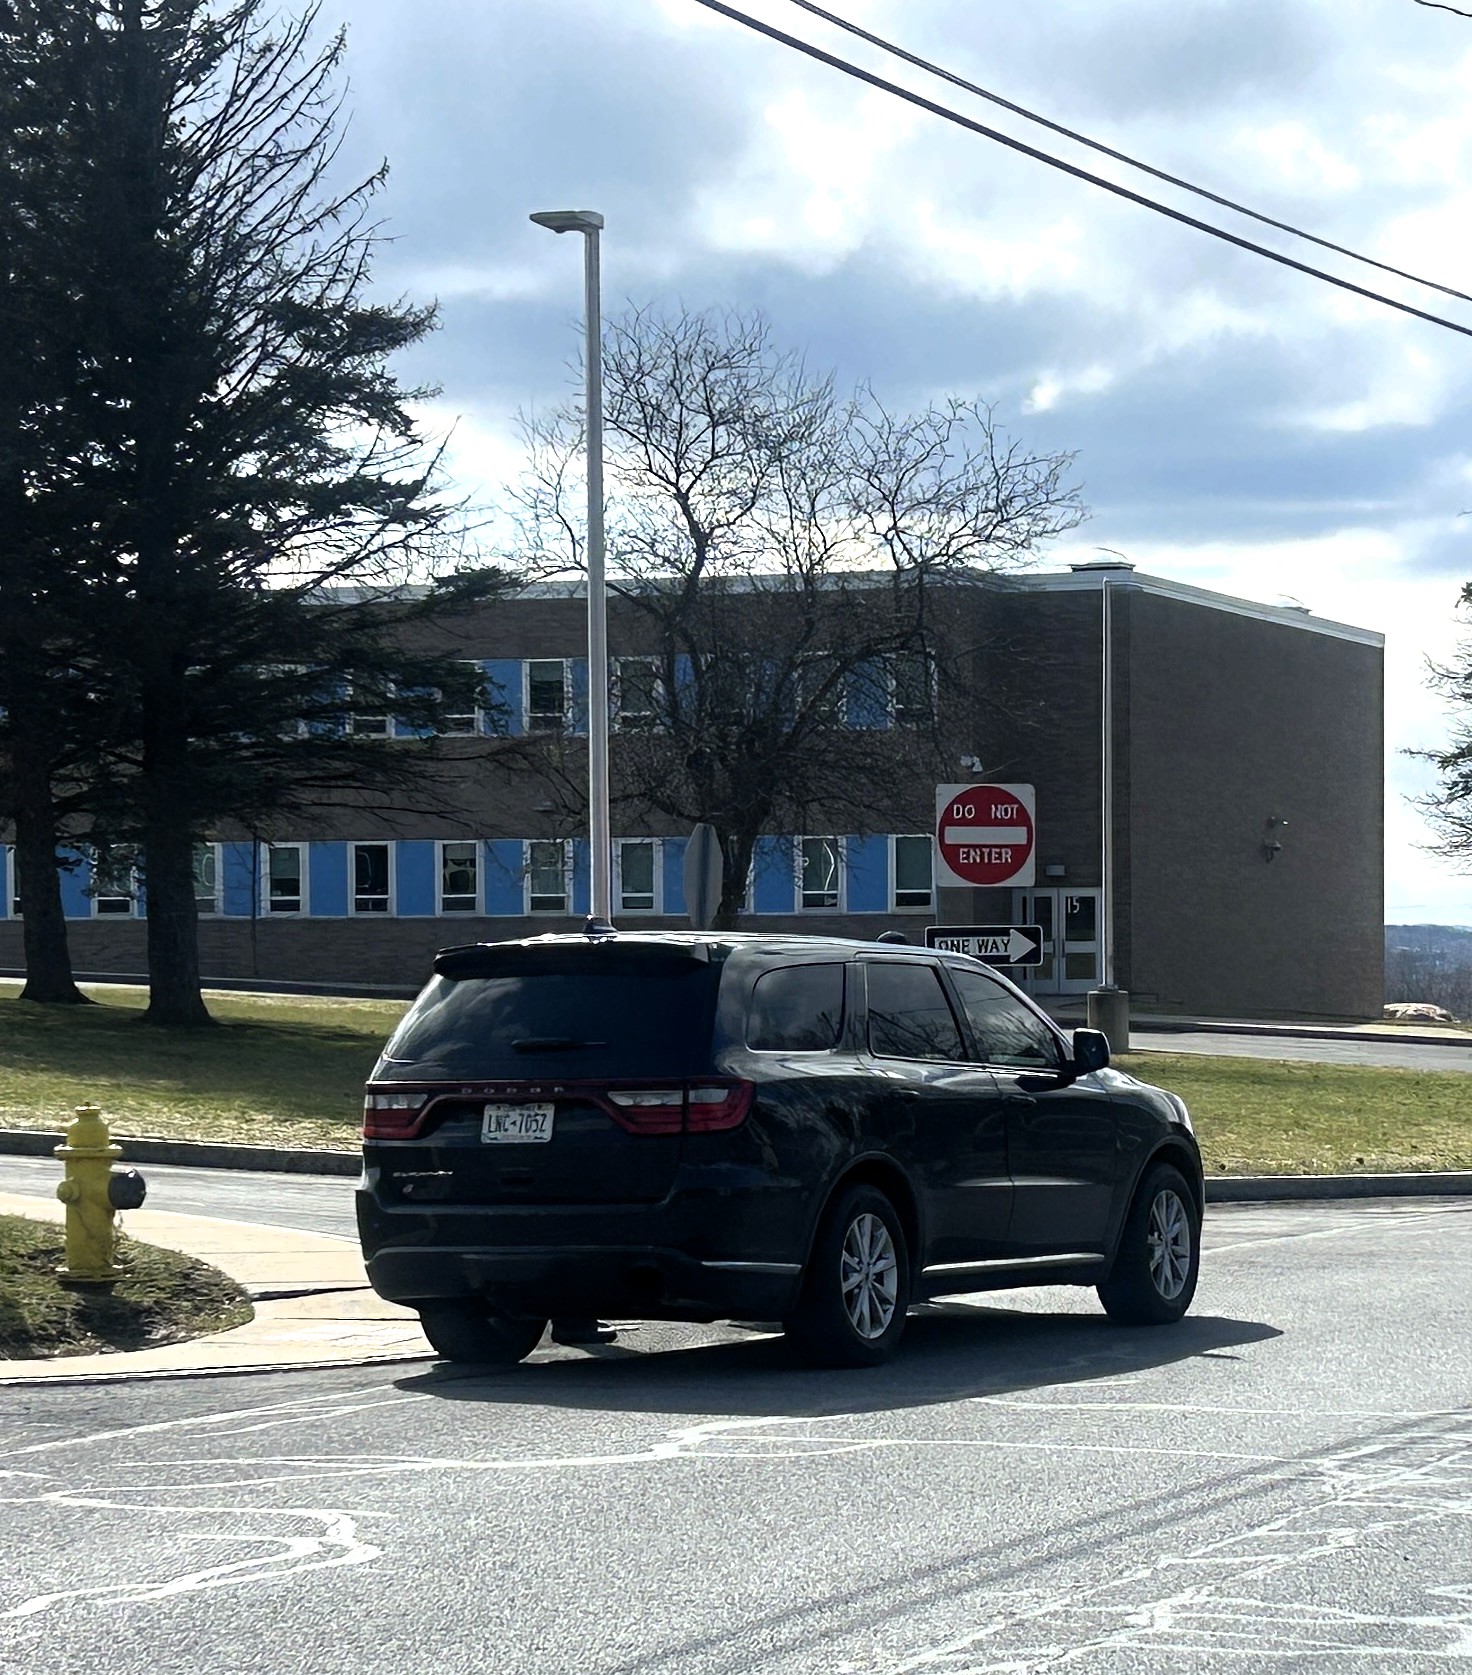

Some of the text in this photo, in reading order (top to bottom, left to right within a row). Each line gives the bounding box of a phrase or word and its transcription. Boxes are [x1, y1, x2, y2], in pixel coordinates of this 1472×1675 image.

[953, 804, 1019, 819] DO NOT
[959, 848, 1012, 864] ENTER
[1067, 897, 1080, 914] 15
[938, 938, 1010, 954] ONE WAY
